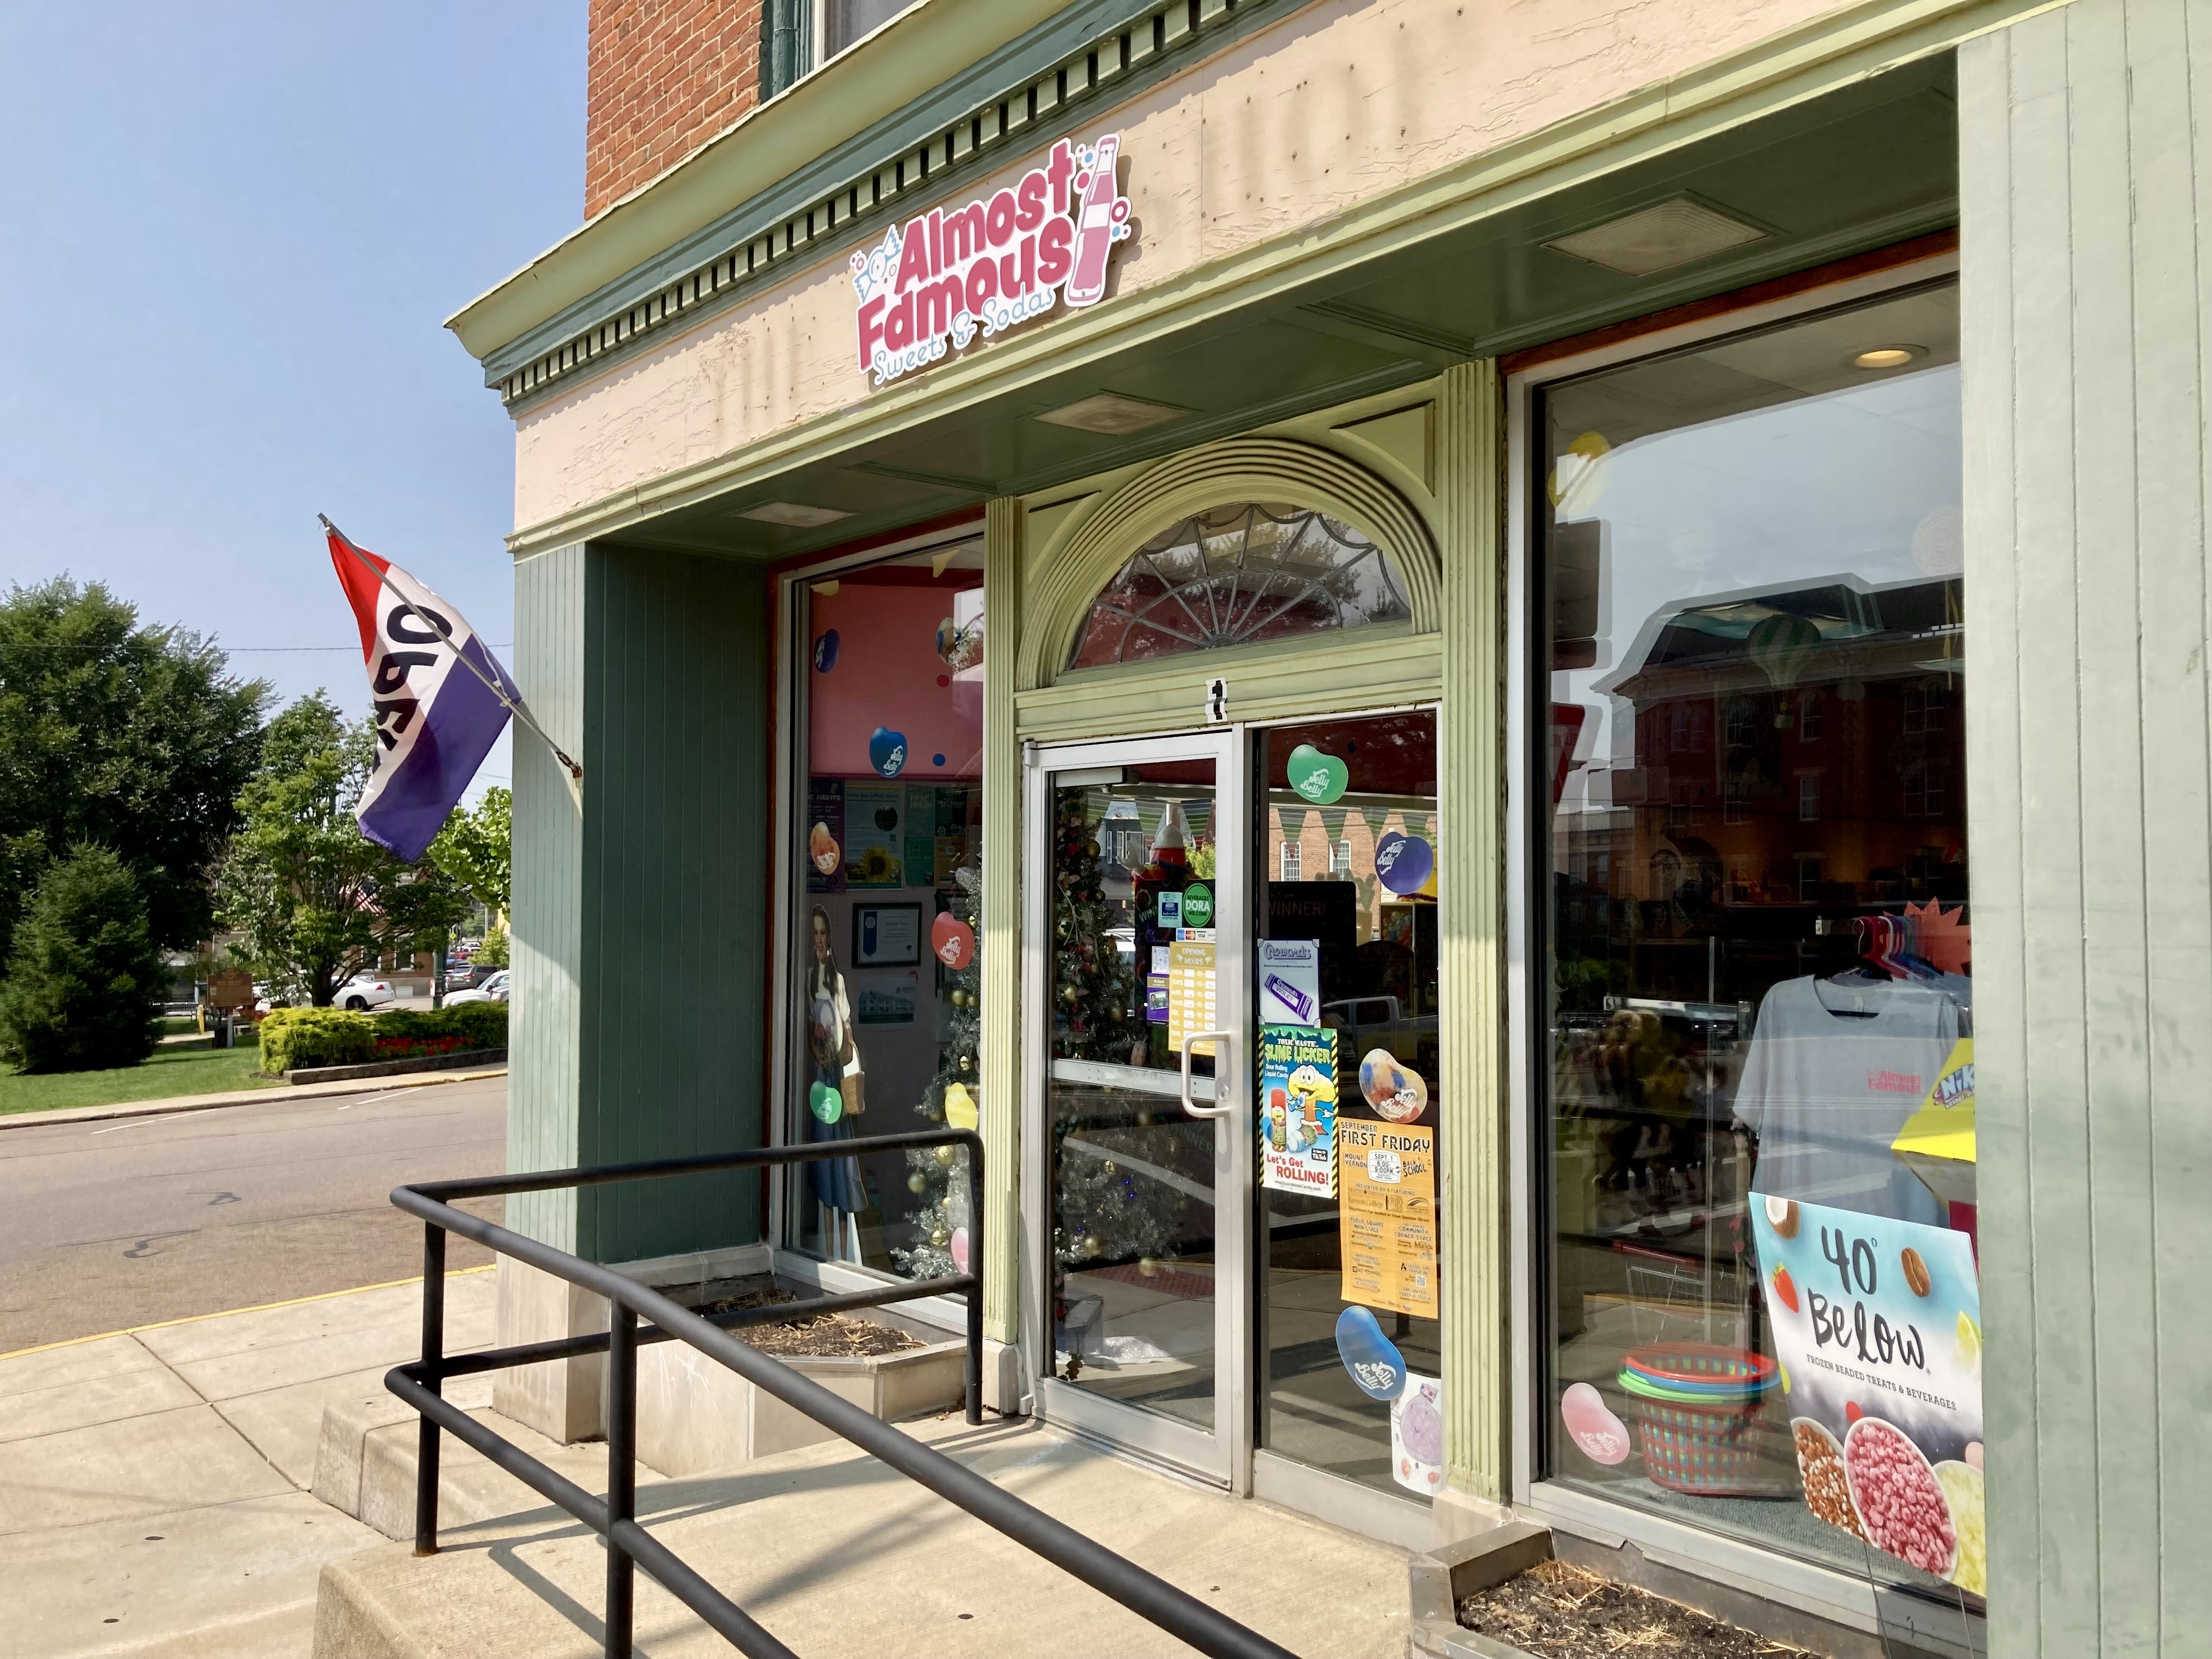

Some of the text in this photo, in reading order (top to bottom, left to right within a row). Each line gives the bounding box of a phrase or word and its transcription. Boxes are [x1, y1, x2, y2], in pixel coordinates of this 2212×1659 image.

[894, 141, 1072, 295] Almost
[859, 218, 1073, 371] Famous
[874, 284, 1055, 385] Sweets & Sodas
[1309, 768, 1329, 790] Jelly
[1300, 780, 1323, 798] Belly
[1186, 900, 1210, 912] DORA
[1182, 947, 1206, 956] OPENING
[1276, 985, 1294, 1001] VIOLET
[1265, 1043, 1331, 1064] SLIME LICKER
[1275, 1064, 1288, 1073] Rolling
[1277, 1071, 1289, 1080] Candy
[1380, 1098, 1408, 1119] Belly
[1395, 1088, 1418, 1113] Jelly
[1341, 1121, 1378, 1132] SEPTEMBER
[1341, 1130, 1430, 1153] FIRST FRIDAY
[1267, 1154, 1304, 1168] Let's Get
[1345, 1160, 1367, 1168] VERNON
[1403, 1164, 1426, 1177] SCHOOL
[1277, 1165, 1329, 1185] ROLLING!
[1356, 1182, 1378, 1191] PRESENTED
[1391, 1188, 1415, 1196] FEATURING
[1350, 1216, 1364, 1224] PUBLIC
[1394, 1231, 1414, 1239] CORNER
[1398, 1226, 1429, 1234] COMMUNITY
[1355, 1362, 1379, 1390] Belly
[1371, 1360, 1396, 1390] Jelly
[1807, 1353, 1957, 1411] FROZEN BEADED TREATS & BEVERAGES
[1579, 1431, 1604, 1455] Belly
[1595, 1431, 1621, 1457] Jelly
